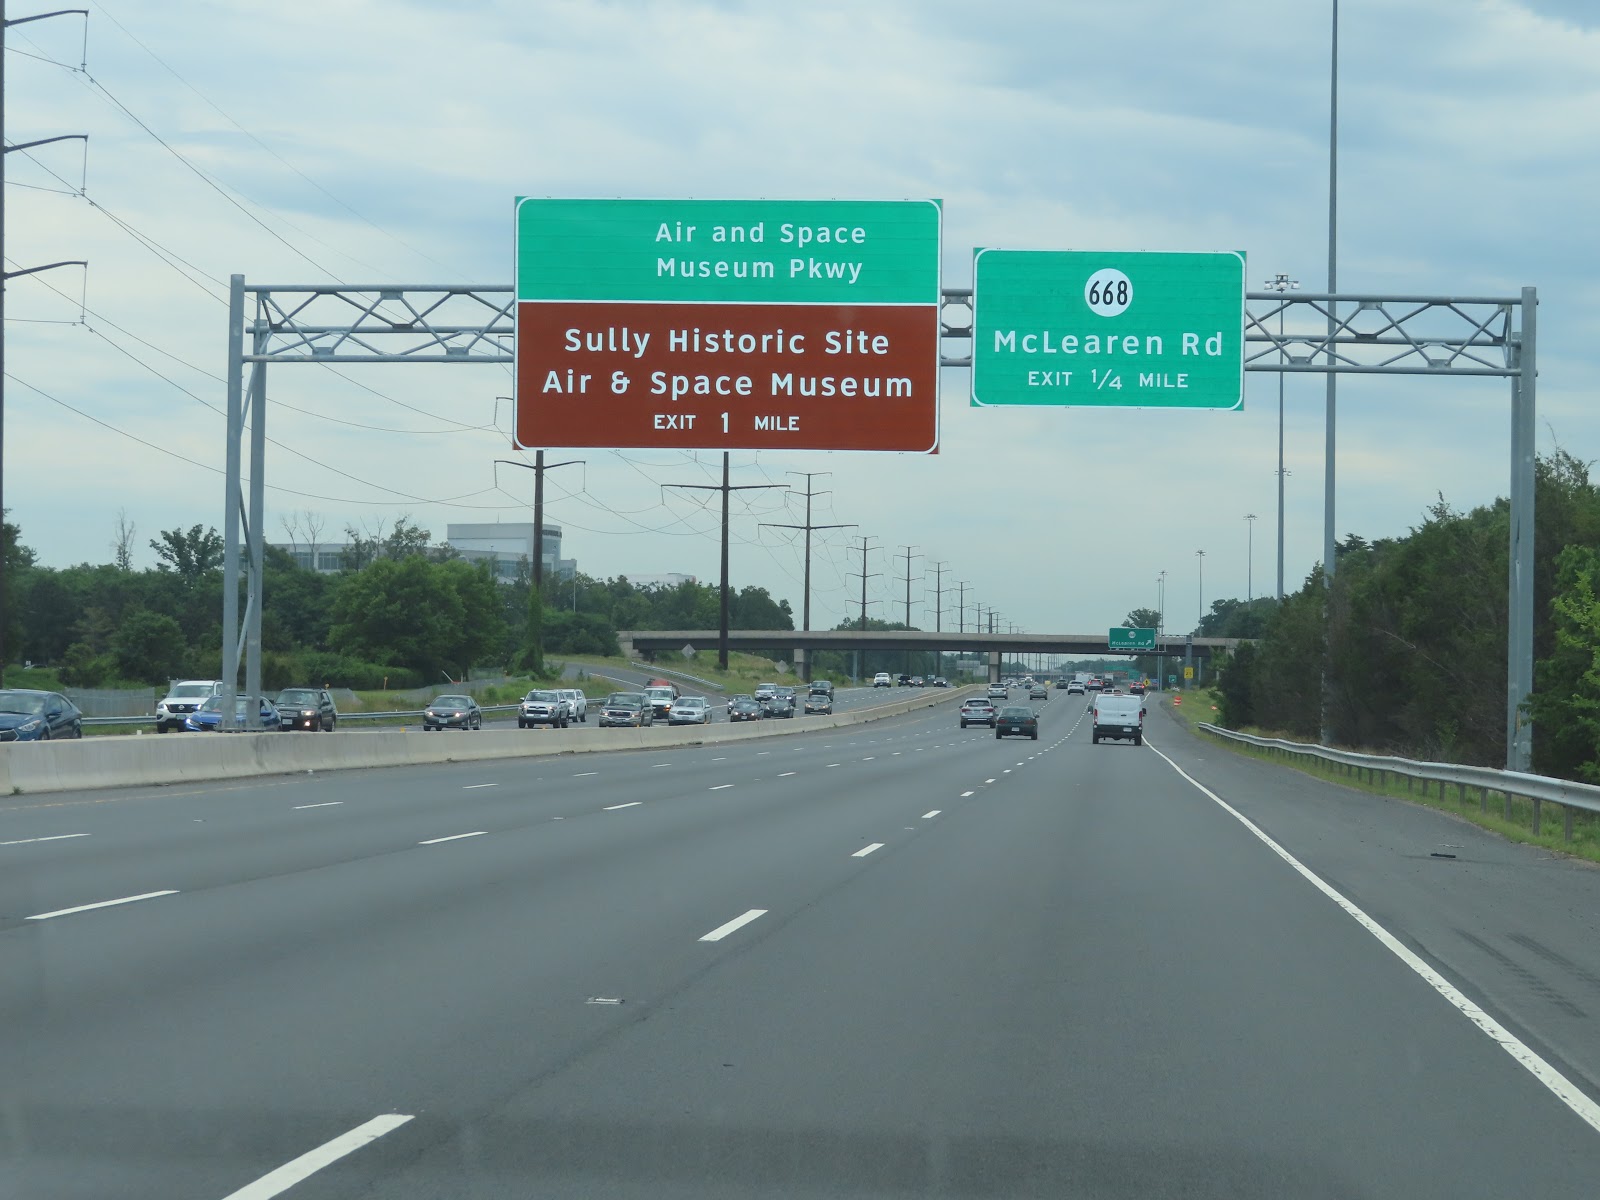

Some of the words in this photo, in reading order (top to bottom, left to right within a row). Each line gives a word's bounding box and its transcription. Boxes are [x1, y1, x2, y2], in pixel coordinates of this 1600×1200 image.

[656, 222, 697, 242] Air
[712, 222, 764, 243] and
[780, 223, 866, 248] Space
[657, 258, 775, 278] Museum
[790, 258, 863, 284] Pkwy
[1089, 280, 1128, 306] 668
[565, 327, 651, 358] Sully
[669, 328, 805, 354] Historic
[825, 330, 889, 355] Site
[994, 331, 1163, 355] McLearen
[1182, 332, 1222, 356] Rd
[543, 369, 592, 394] Air
[611, 371, 631, 394] &
[651, 371, 753, 400] Space
[771, 373, 912, 397] Museum
[1028, 371, 1073, 386] EXIT
[1091, 369, 1123, 390] 1/4
[1139, 373, 1189, 388] MILE
[654, 414, 697, 430] EXIT
[721, 412, 729, 434] 1
[754, 415, 800, 431] MILE
